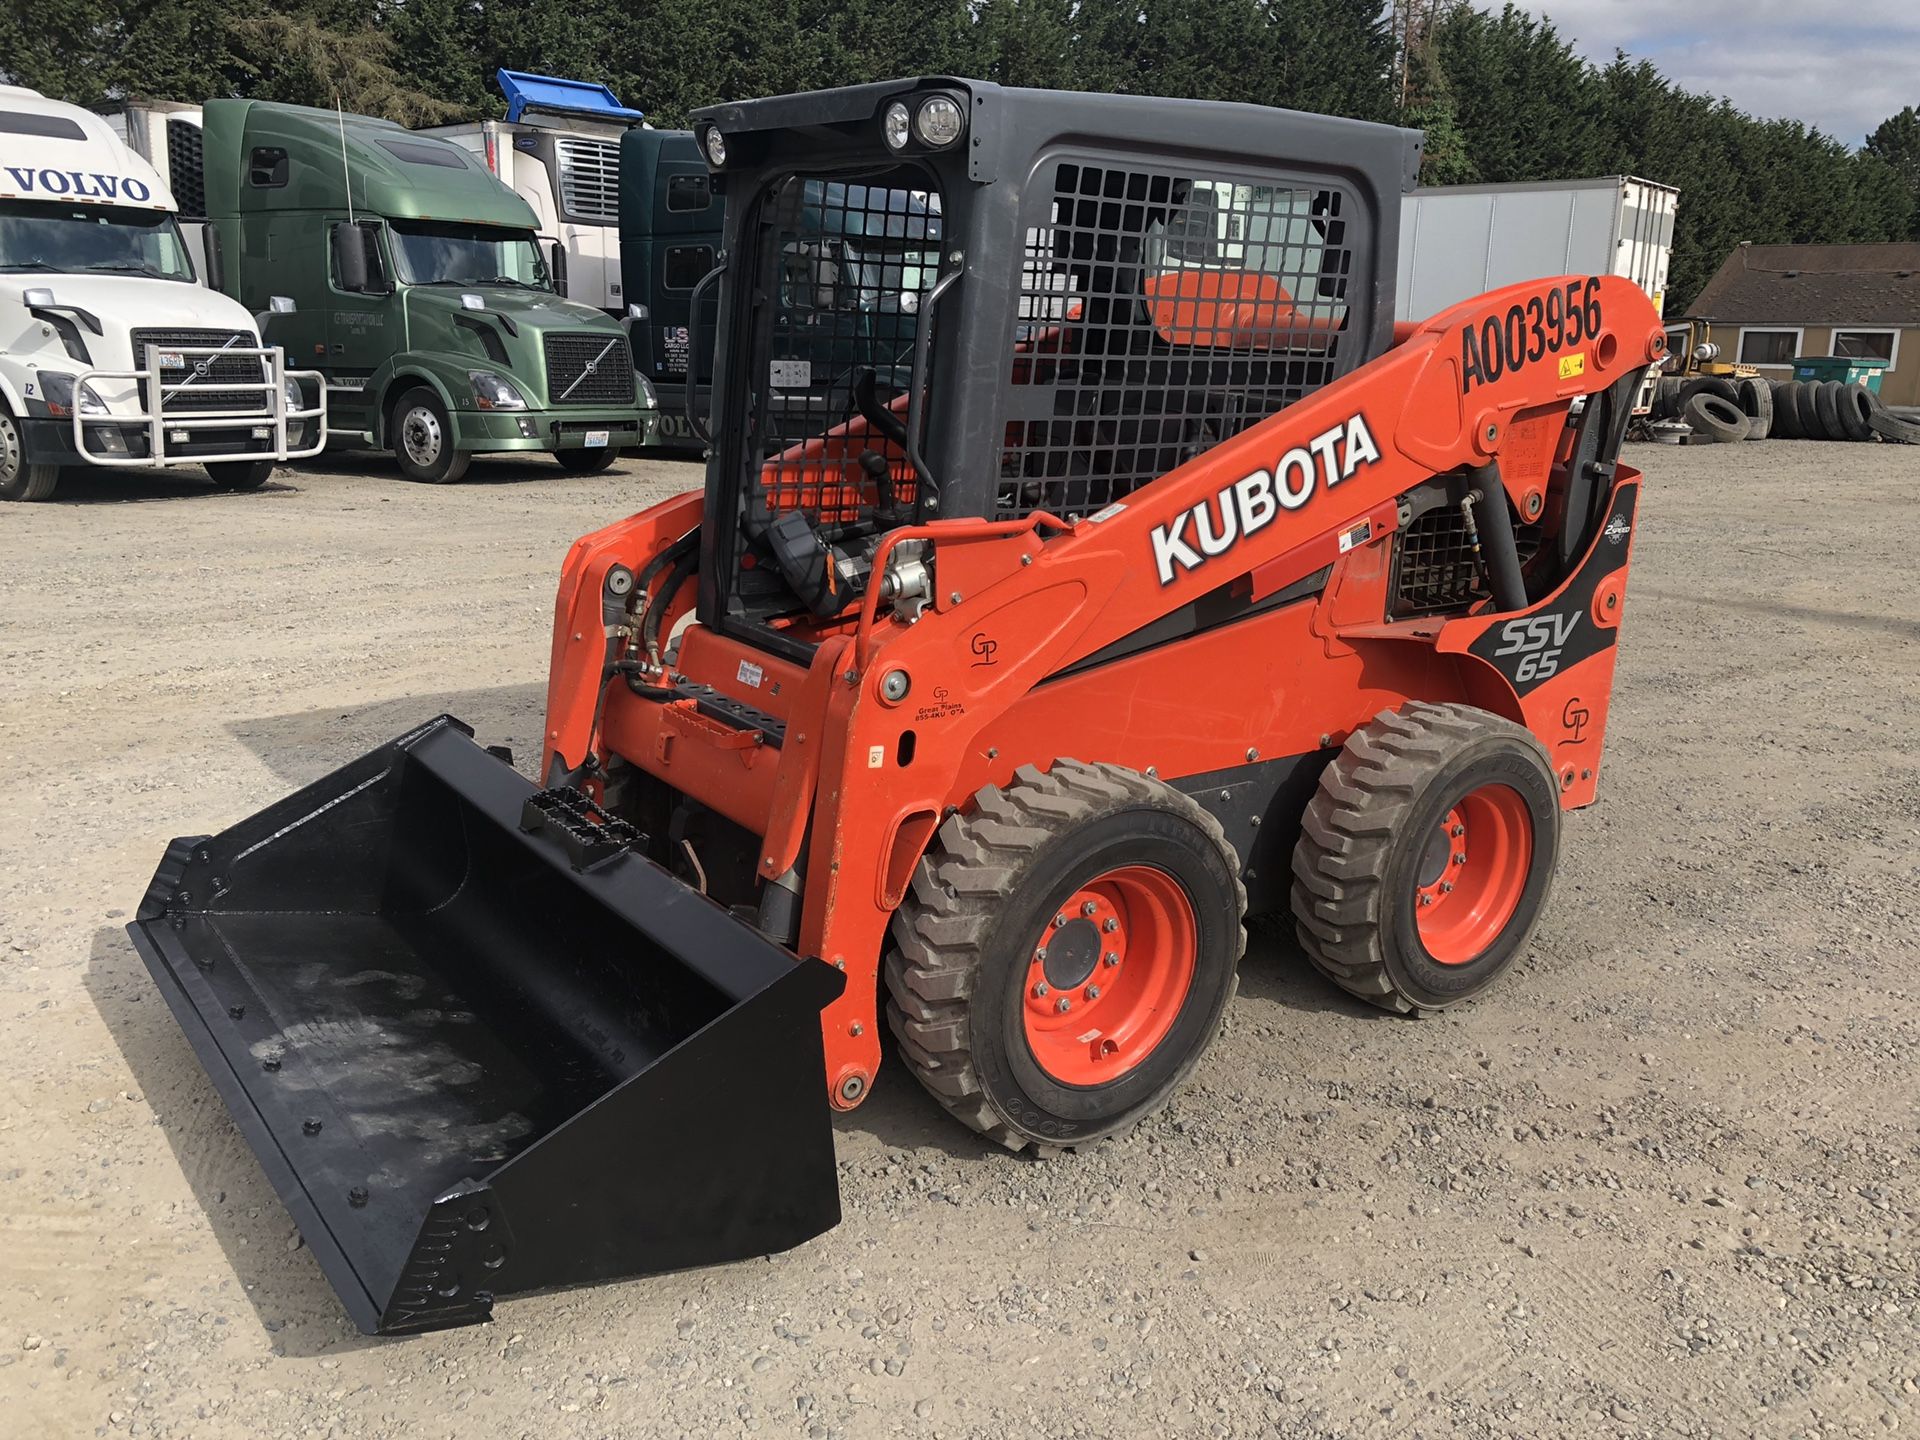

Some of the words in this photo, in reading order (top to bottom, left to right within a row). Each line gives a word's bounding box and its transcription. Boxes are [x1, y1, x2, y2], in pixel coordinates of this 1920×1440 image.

[3, 167, 150, 201] VOLVO
[663, 326, 689, 343] US
[1462, 276, 1601, 395] A003956
[25, 383, 34, 395] 12
[462, 398, 470, 406] 15
[1150, 413, 1381, 586] KUBOTA
[1494, 610, 1583, 657] SSV
[1515, 649, 1562, 683] 65
[918, 707, 939, 715] Great
[941, 703, 962, 711] Plains
[1006, 1097, 1079, 1137] 2000
